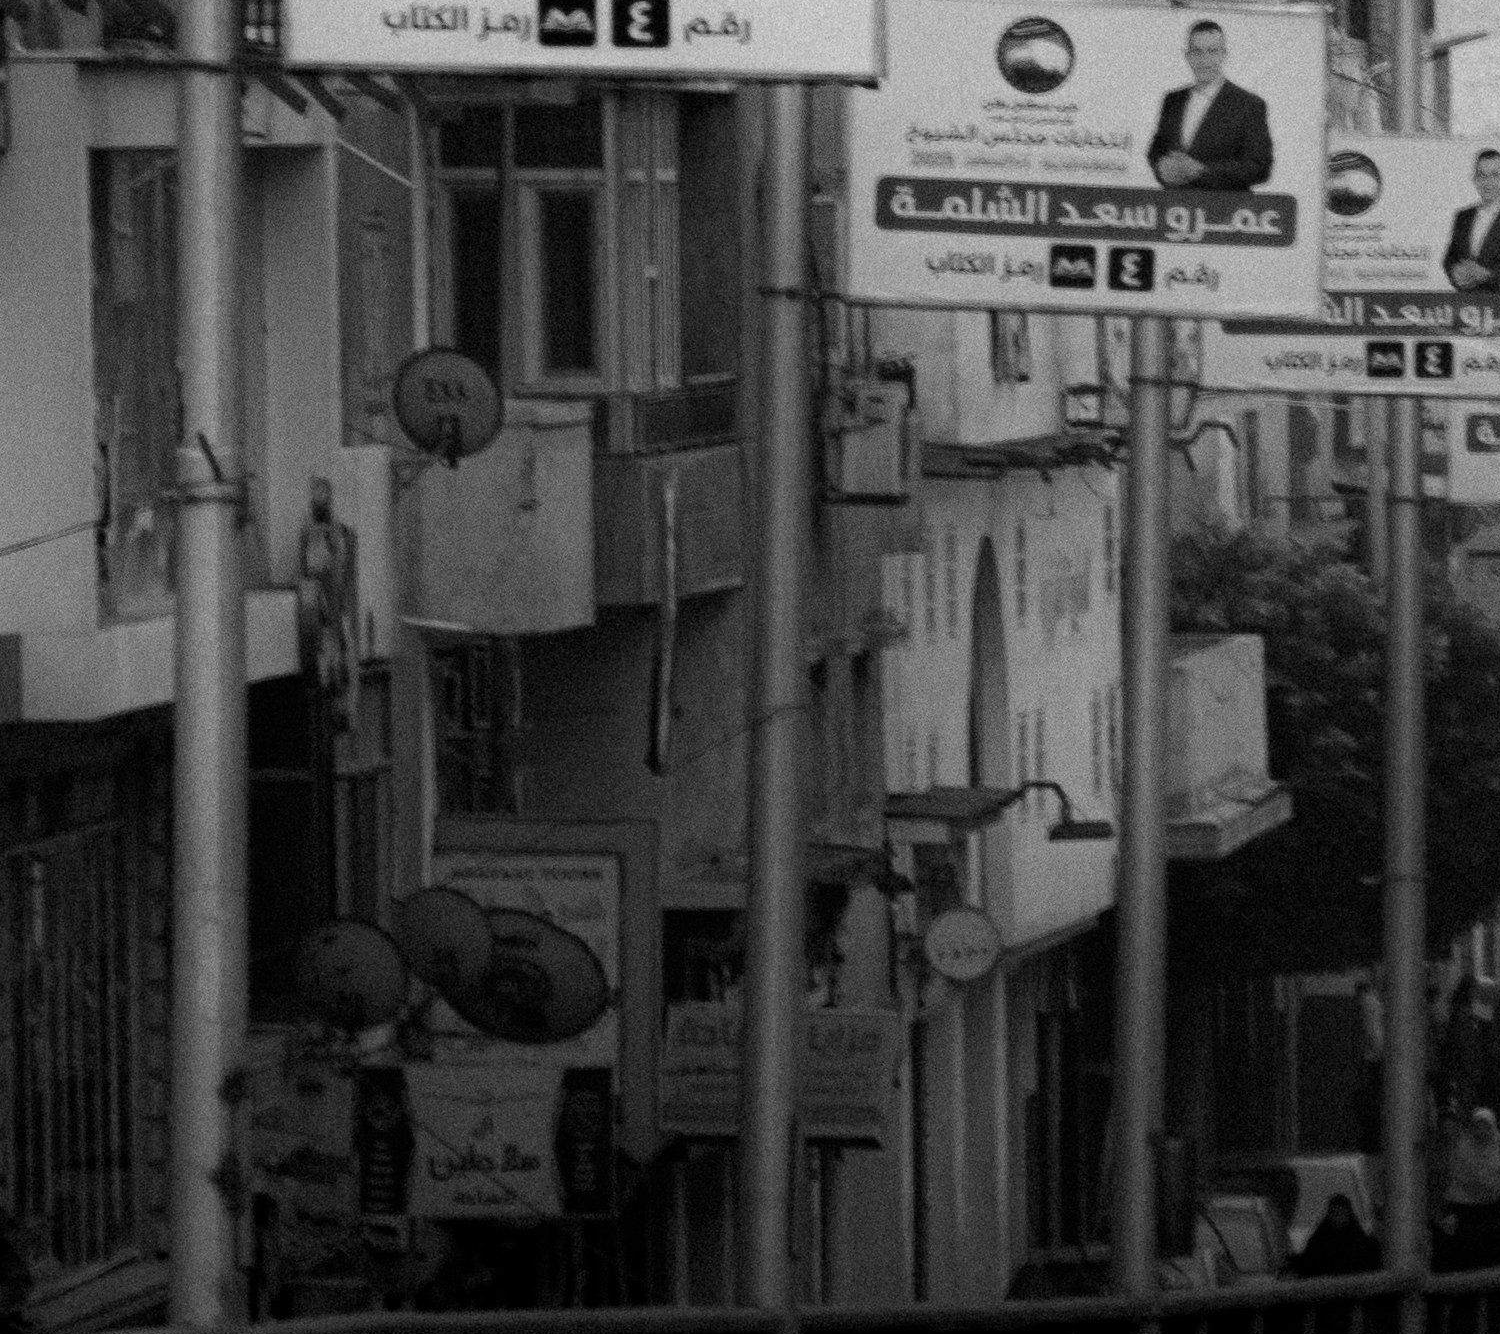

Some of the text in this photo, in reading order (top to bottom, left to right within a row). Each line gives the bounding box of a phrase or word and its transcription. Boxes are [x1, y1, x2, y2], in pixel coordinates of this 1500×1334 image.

[380, 0, 753, 45] رقم ٤ رمز الكتاب
[890, 185, 1050, 225] الشلمة
[1059, 202, 1156, 230] سعد
[1165, 206, 1283, 242] عمرو
[924, 252, 1220, 291] رقم ٤ رمز الكتاب
[1370, 303, 1453, 329] سعد
[1424, 345, 1443, 375] ٤
